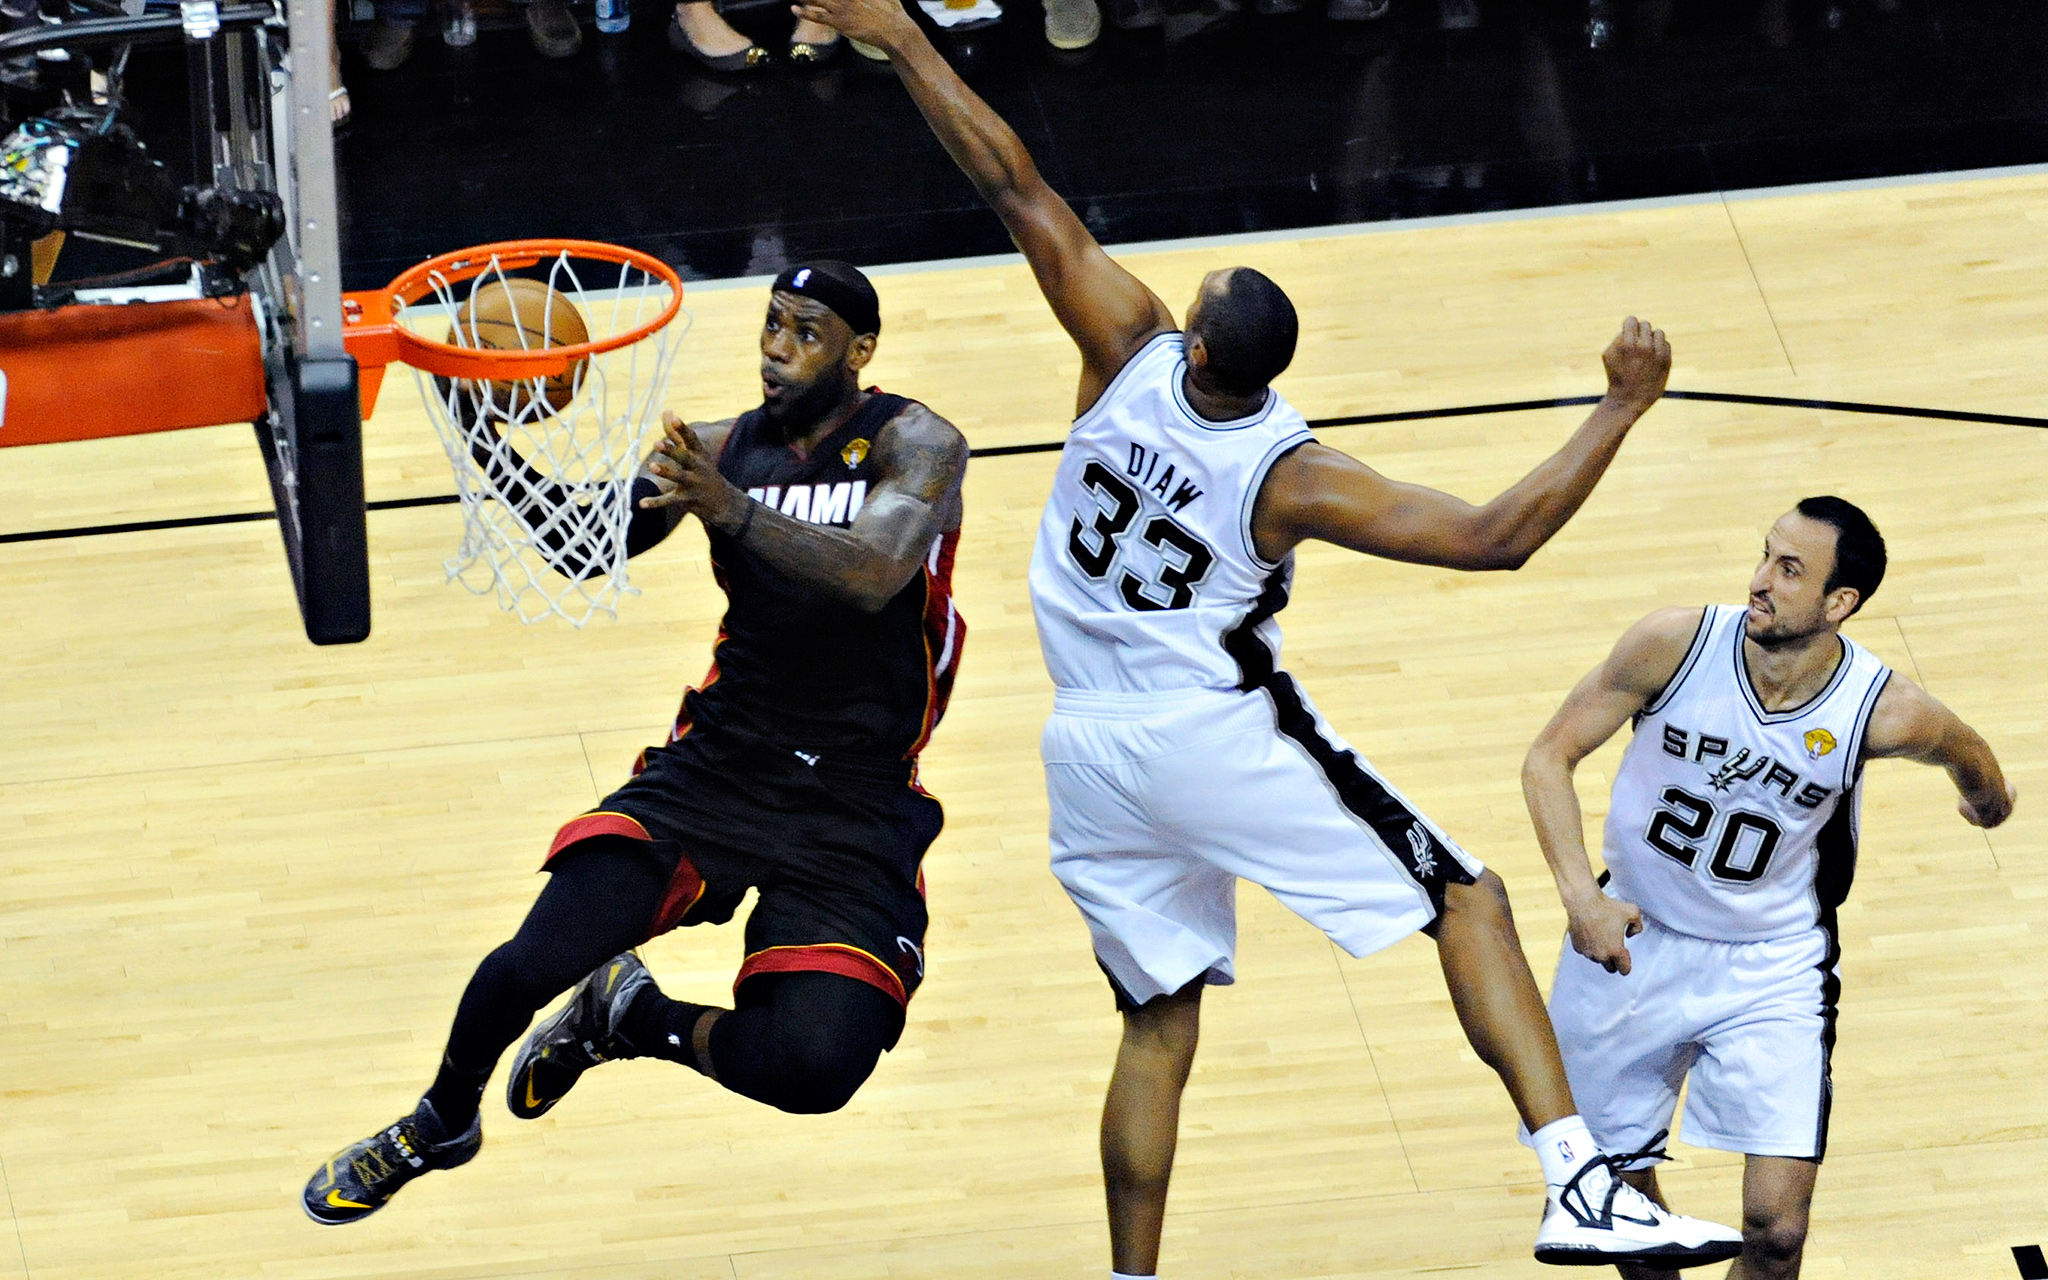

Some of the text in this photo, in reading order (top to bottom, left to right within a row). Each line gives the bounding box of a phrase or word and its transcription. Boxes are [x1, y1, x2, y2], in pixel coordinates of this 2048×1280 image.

[1127, 441, 1204, 514] DIAW
[1066, 457, 1219, 613] 33
[1662, 721, 1832, 809] SPURS
[1643, 784, 1787, 886] 20
